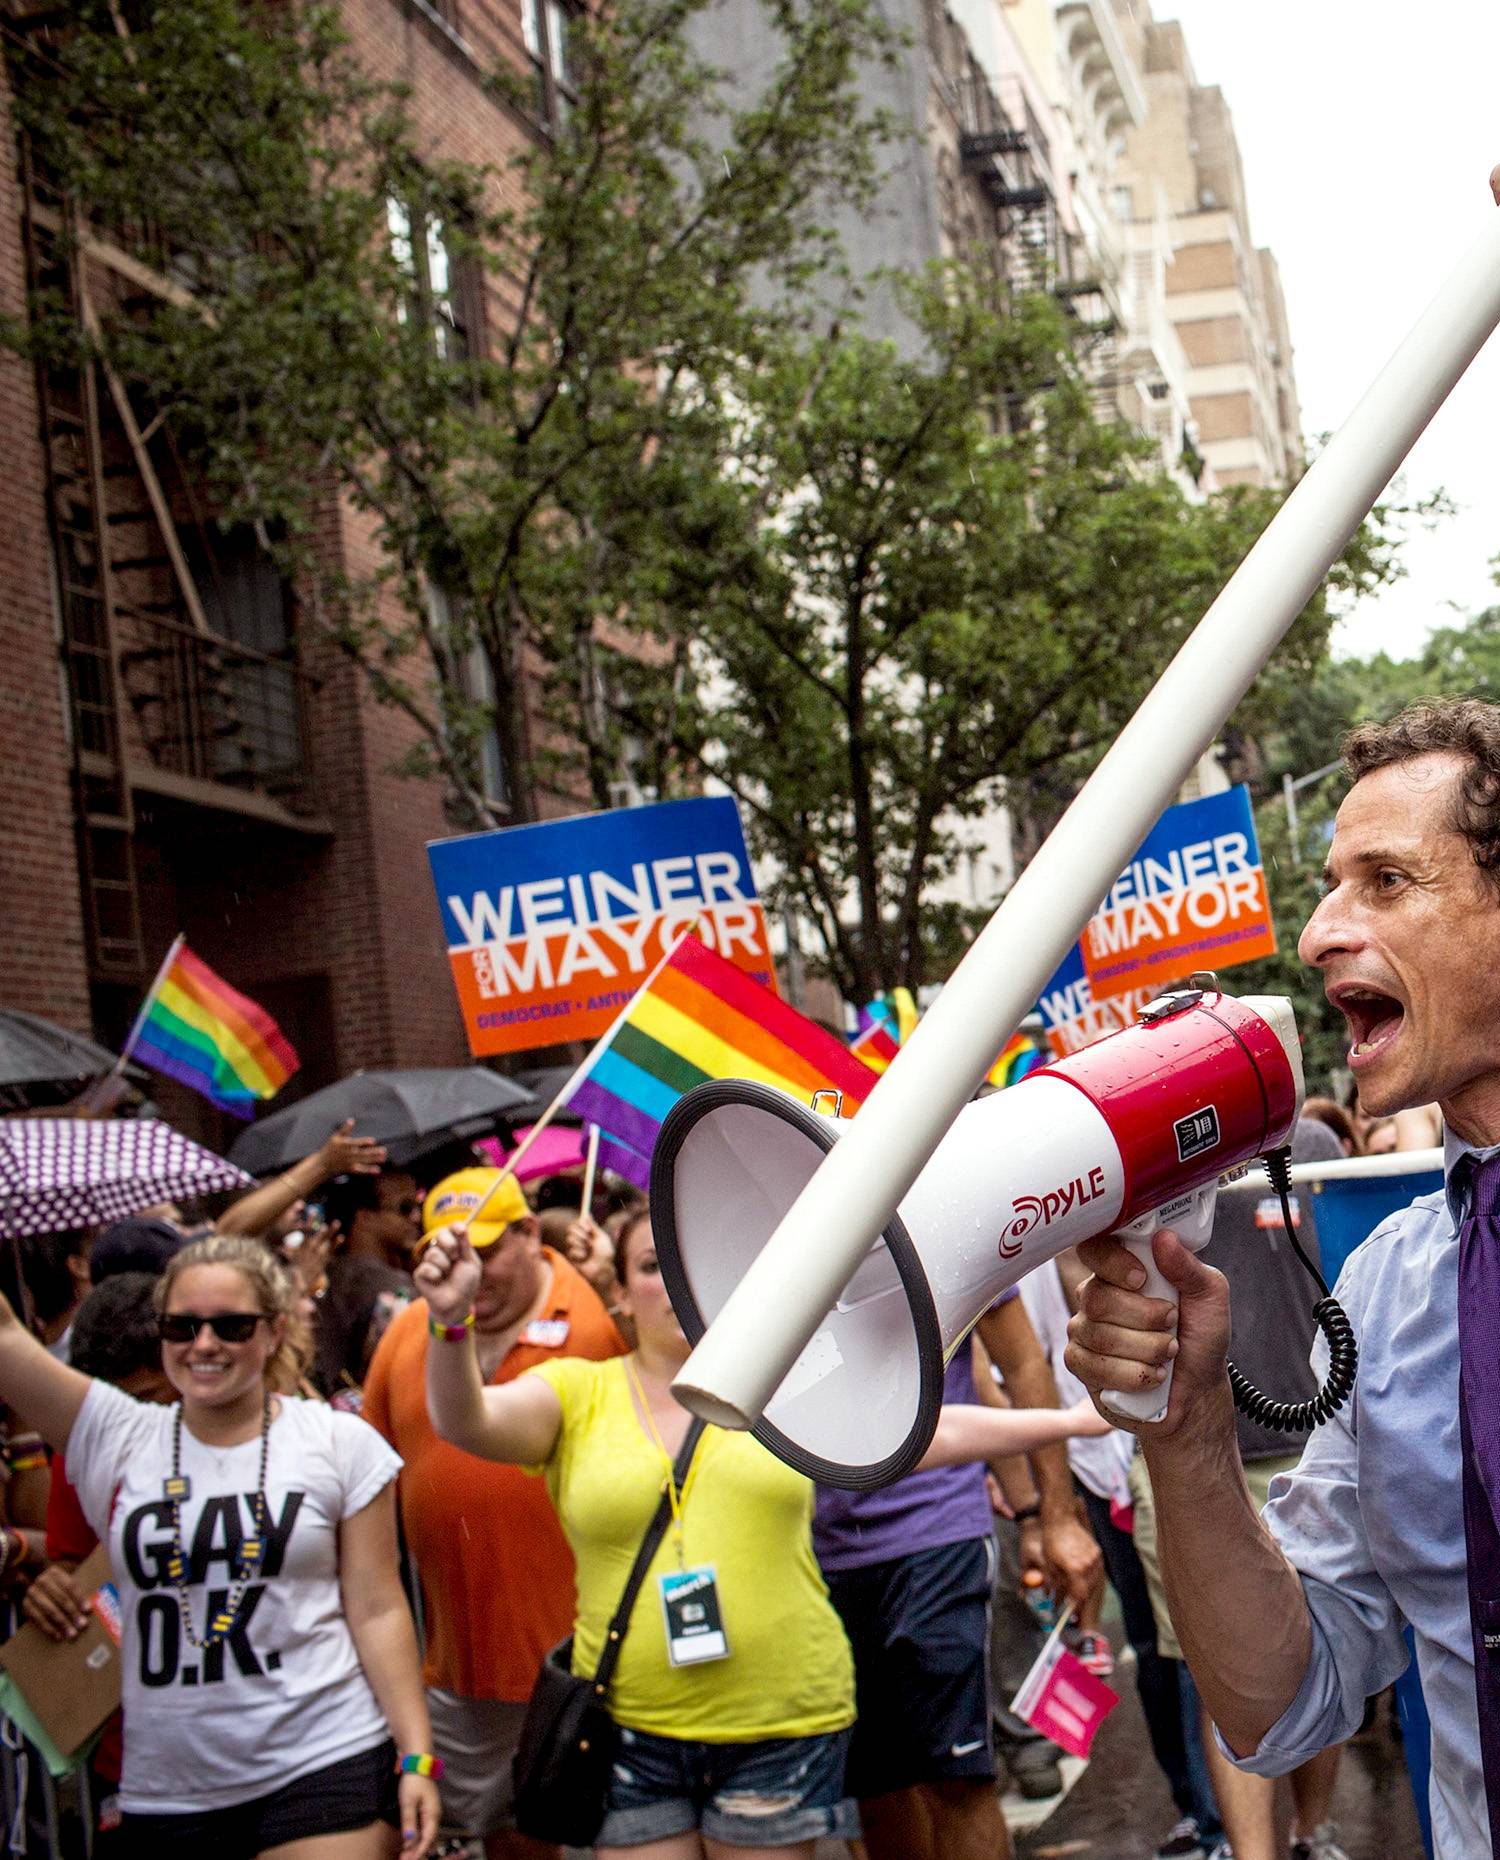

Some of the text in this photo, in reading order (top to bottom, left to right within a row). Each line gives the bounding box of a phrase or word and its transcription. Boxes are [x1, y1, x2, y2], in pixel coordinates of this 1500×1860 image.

[448, 851, 749, 948] WEINER
[1104, 831, 1252, 911] EINER
[490, 901, 764, 998] MAYOR
[1095, 872, 1263, 958] MAYOR
[472, 948, 499, 999] FOR
[477, 1000, 572, 1029] DEMOCRAT
[1044, 1166, 1106, 1225] PYLE
[1159, 1194, 1192, 1217] MEGAPHONE
[123, 1491, 305, 1591] GAY
[137, 1585, 282, 1688] O.K.
